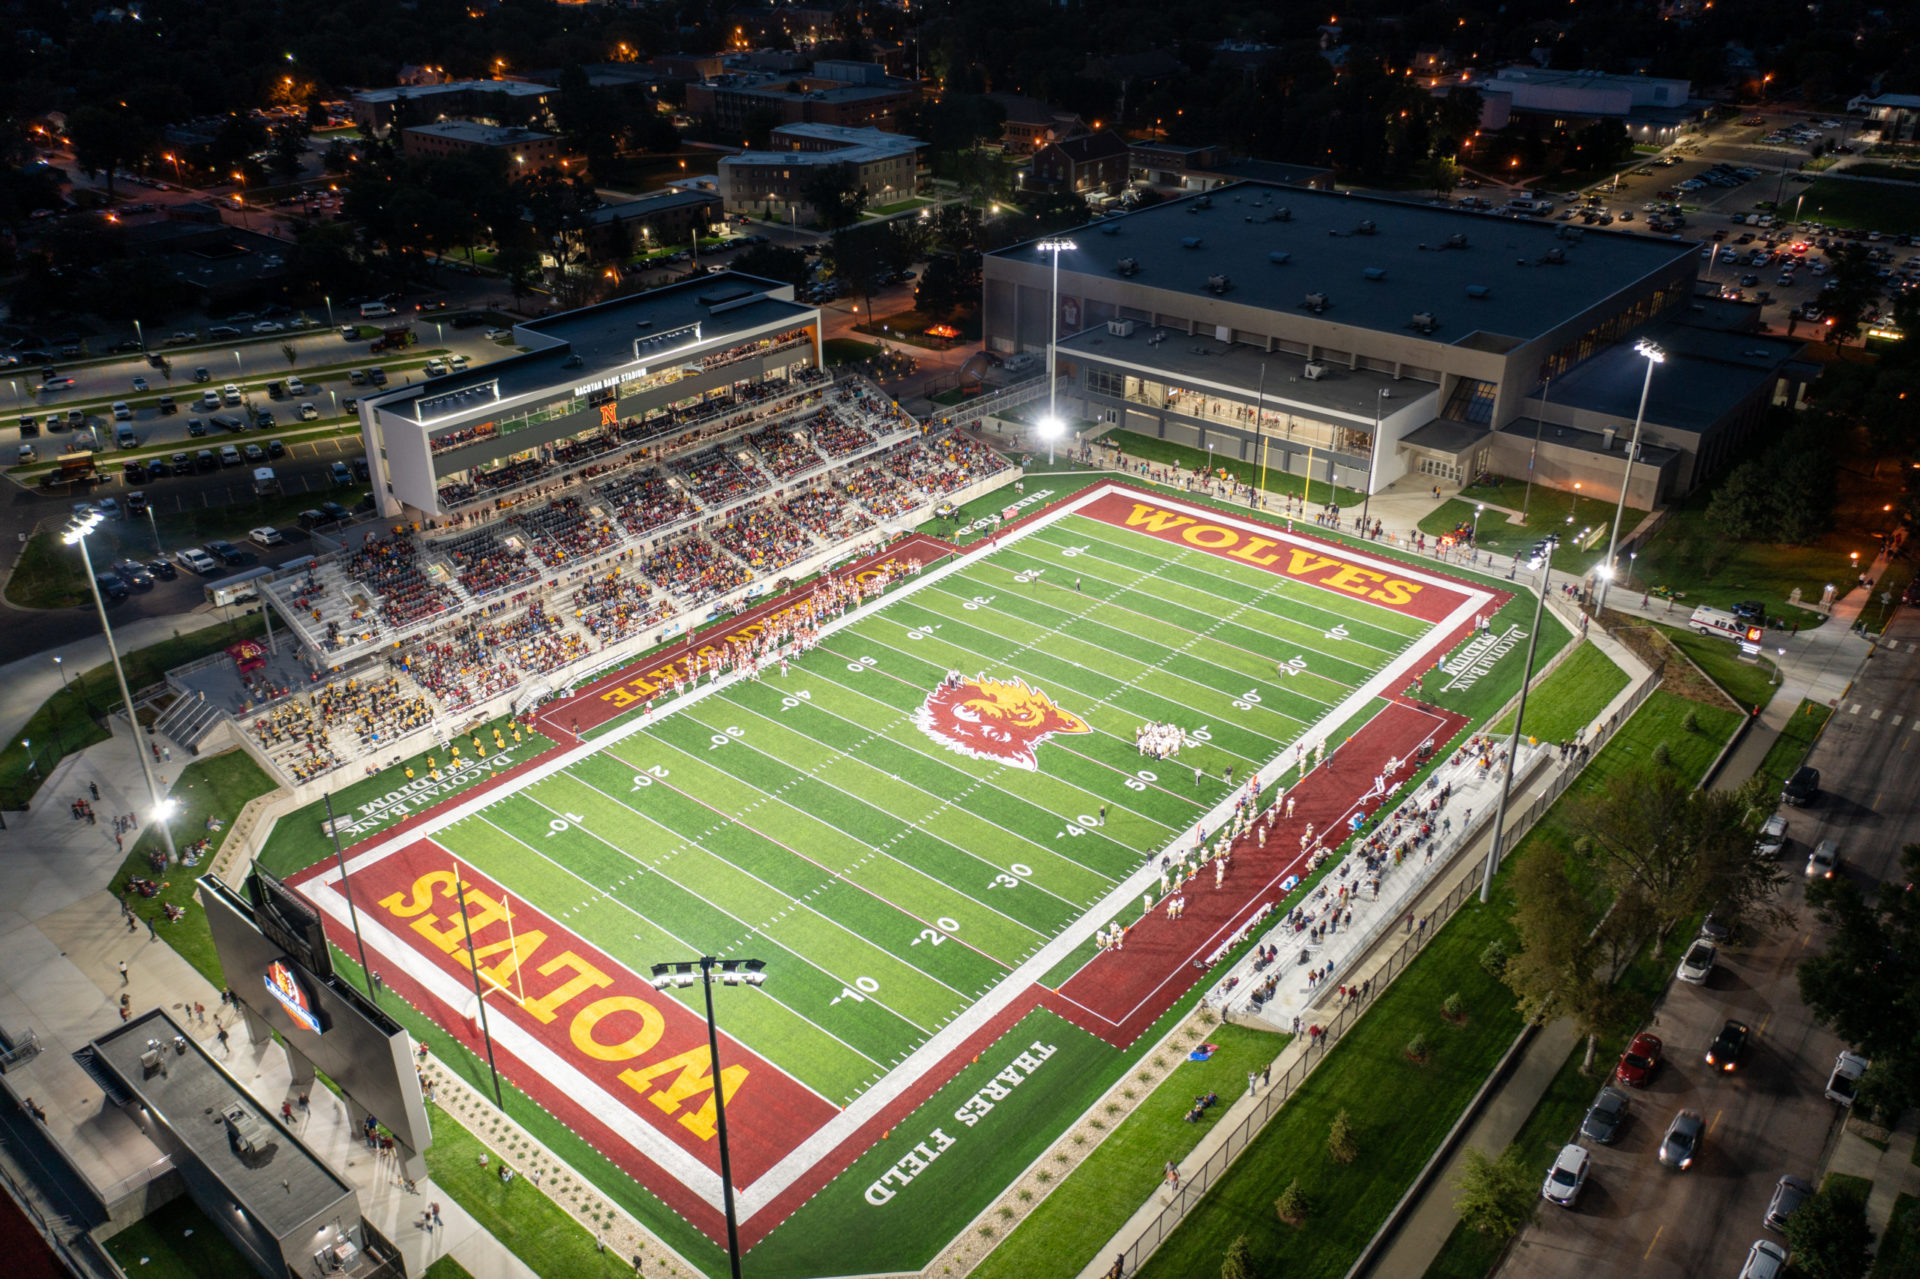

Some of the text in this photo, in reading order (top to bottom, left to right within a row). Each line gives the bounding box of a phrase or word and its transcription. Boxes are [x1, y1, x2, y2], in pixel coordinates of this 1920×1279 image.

[574, 367, 647, 397] DACOTAH BANK STADIUM
[600, 402, 617, 425] N
[1124, 503, 1424, 605] WOLVES
[963, 597, 990, 610] 30
[907, 626, 934, 640] 40
[847, 656, 878, 672] 50
[1441, 633, 1498, 676] STADIUM
[1450, 629, 1529, 692] DACOTAH BANK
[782, 690, 811, 707] 40
[1231, 693, 1262, 711] 30
[711, 726, 745, 745] 30
[1182, 729, 1212, 749] 40
[633, 764, 669, 787] 20
[1123, 770, 1158, 791] 50
[343, 755, 515, 838] DACOTAH BANK
[549, 812, 585, 832] 10
[1063, 814, 1098, 837] 40
[994, 863, 1033, 889] 30
[919, 916, 960, 947] 20
[841, 976, 880, 1004] 10
[378, 870, 750, 1142] WOLVES
[864, 1041, 1058, 1206] THARES FIELD
